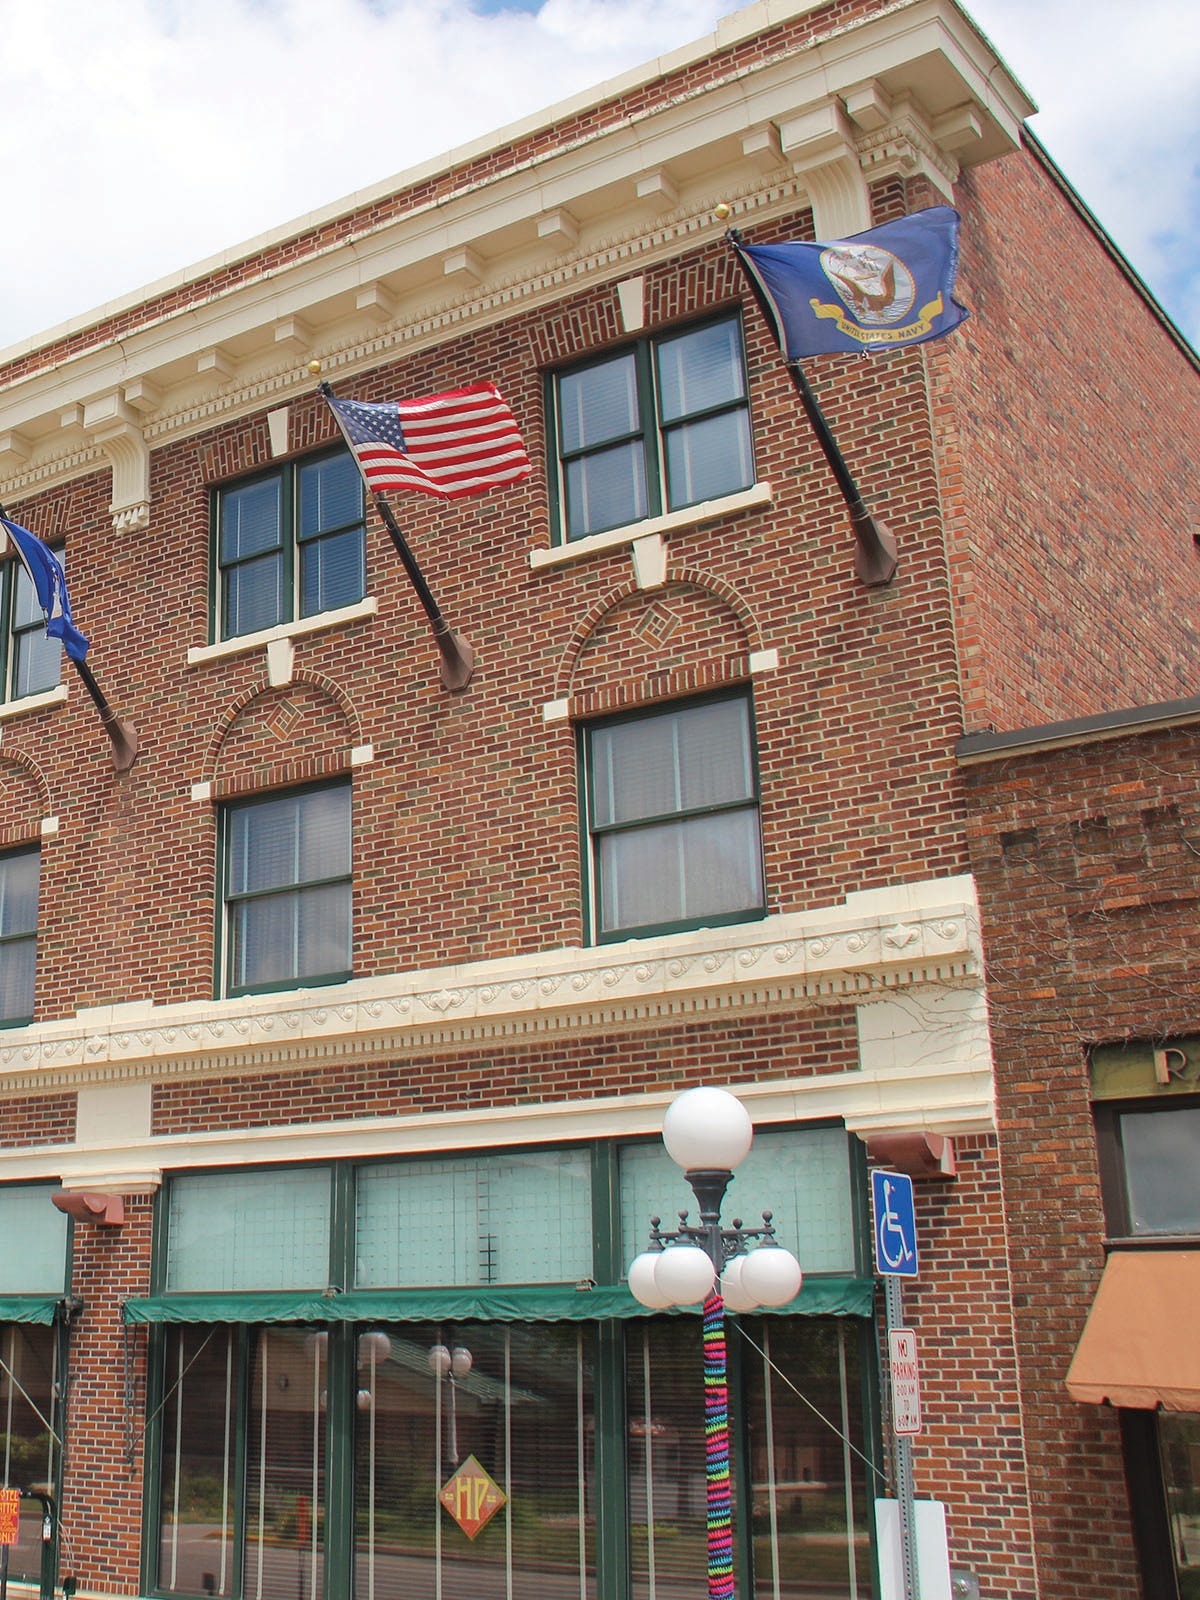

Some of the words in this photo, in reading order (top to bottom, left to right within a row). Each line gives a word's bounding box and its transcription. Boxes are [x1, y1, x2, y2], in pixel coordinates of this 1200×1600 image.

[860, 332, 893, 341] STATES
[898, 323, 925, 338] NAVY
[1153, 1048, 1200, 1084] R
[897, 1339, 908, 1358] NO
[892, 1361, 916, 1381] PARKING
[908, 1384, 915, 1395] AM
[910, 1414, 918, 1426] AM
[455, 1476, 490, 1521] HP
